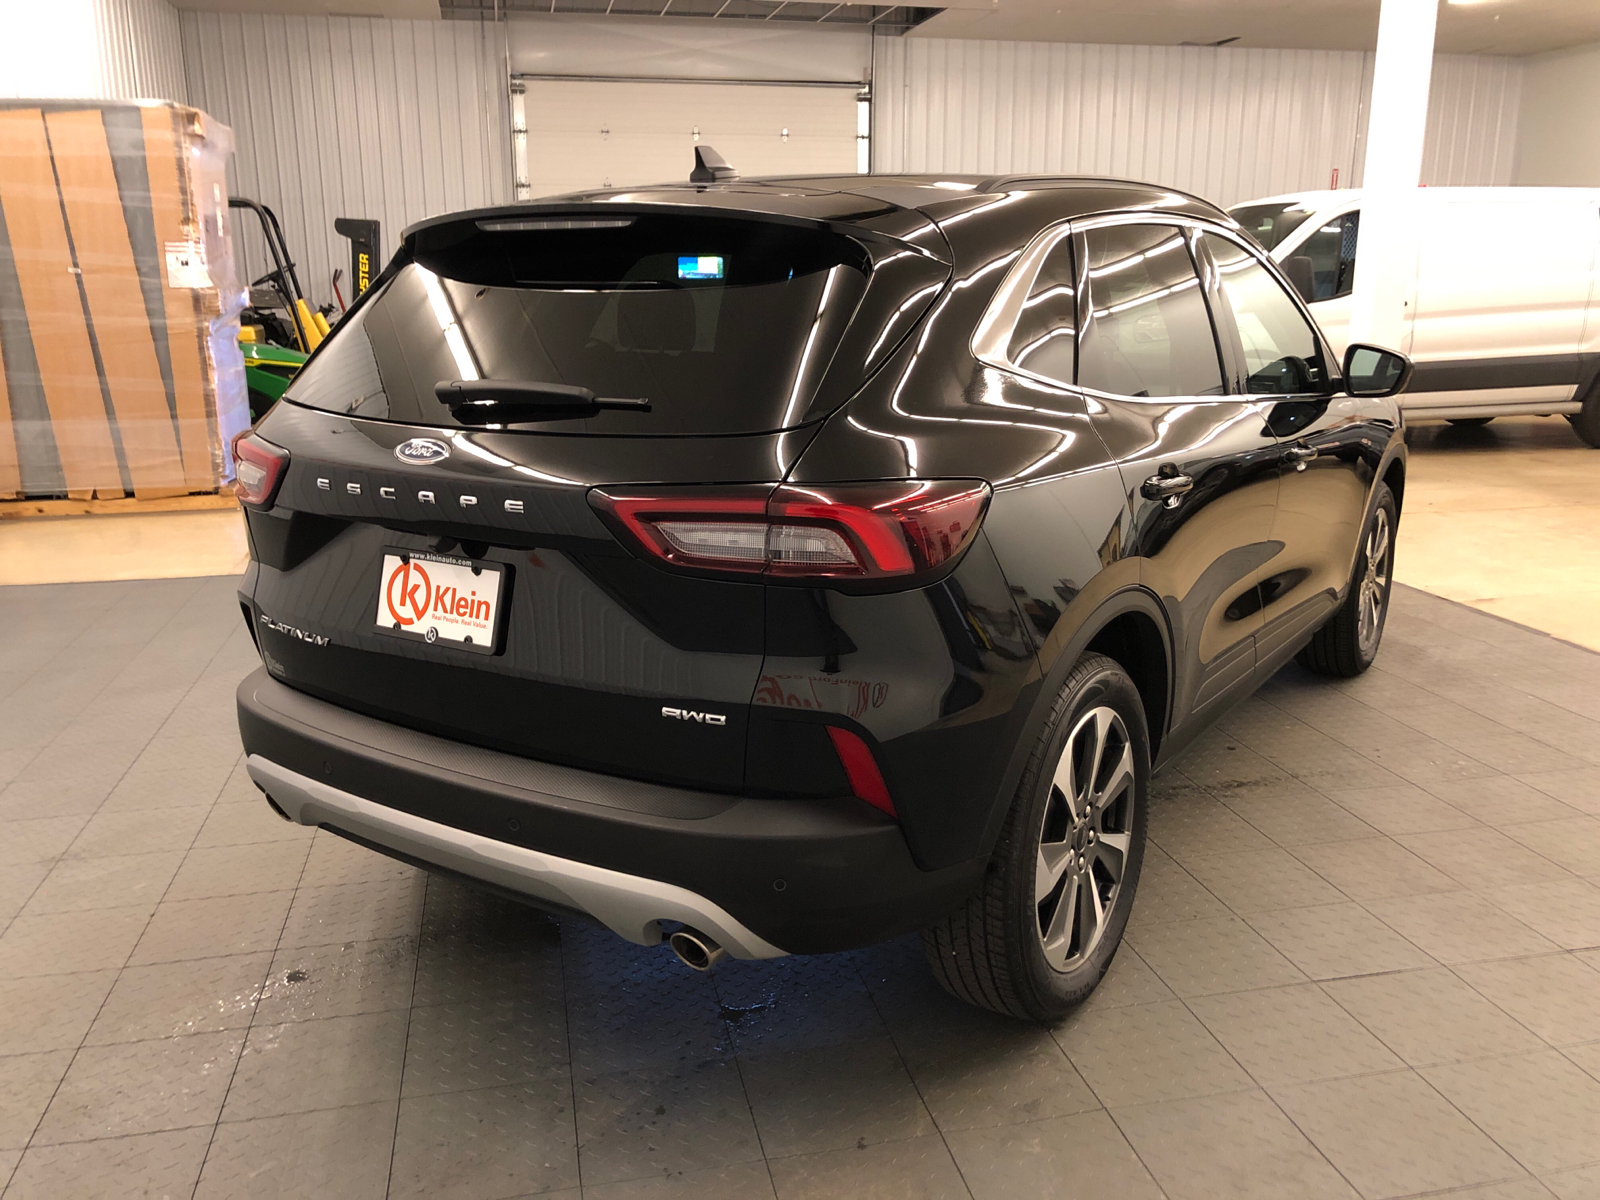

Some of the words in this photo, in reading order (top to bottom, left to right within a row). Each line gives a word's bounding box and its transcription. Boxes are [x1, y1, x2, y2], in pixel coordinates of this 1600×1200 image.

[316, 477, 525, 514] ESCAPE
[409, 552, 472, 567] www.kleinauto.com
[433, 585, 491, 621] Klein
[260, 614, 330, 647] PLATINUM
[431, 613, 442, 621] Real
[461, 618, 472, 626] Real
[473, 620, 488, 629] Value.
[661, 706, 727, 726] AWD
